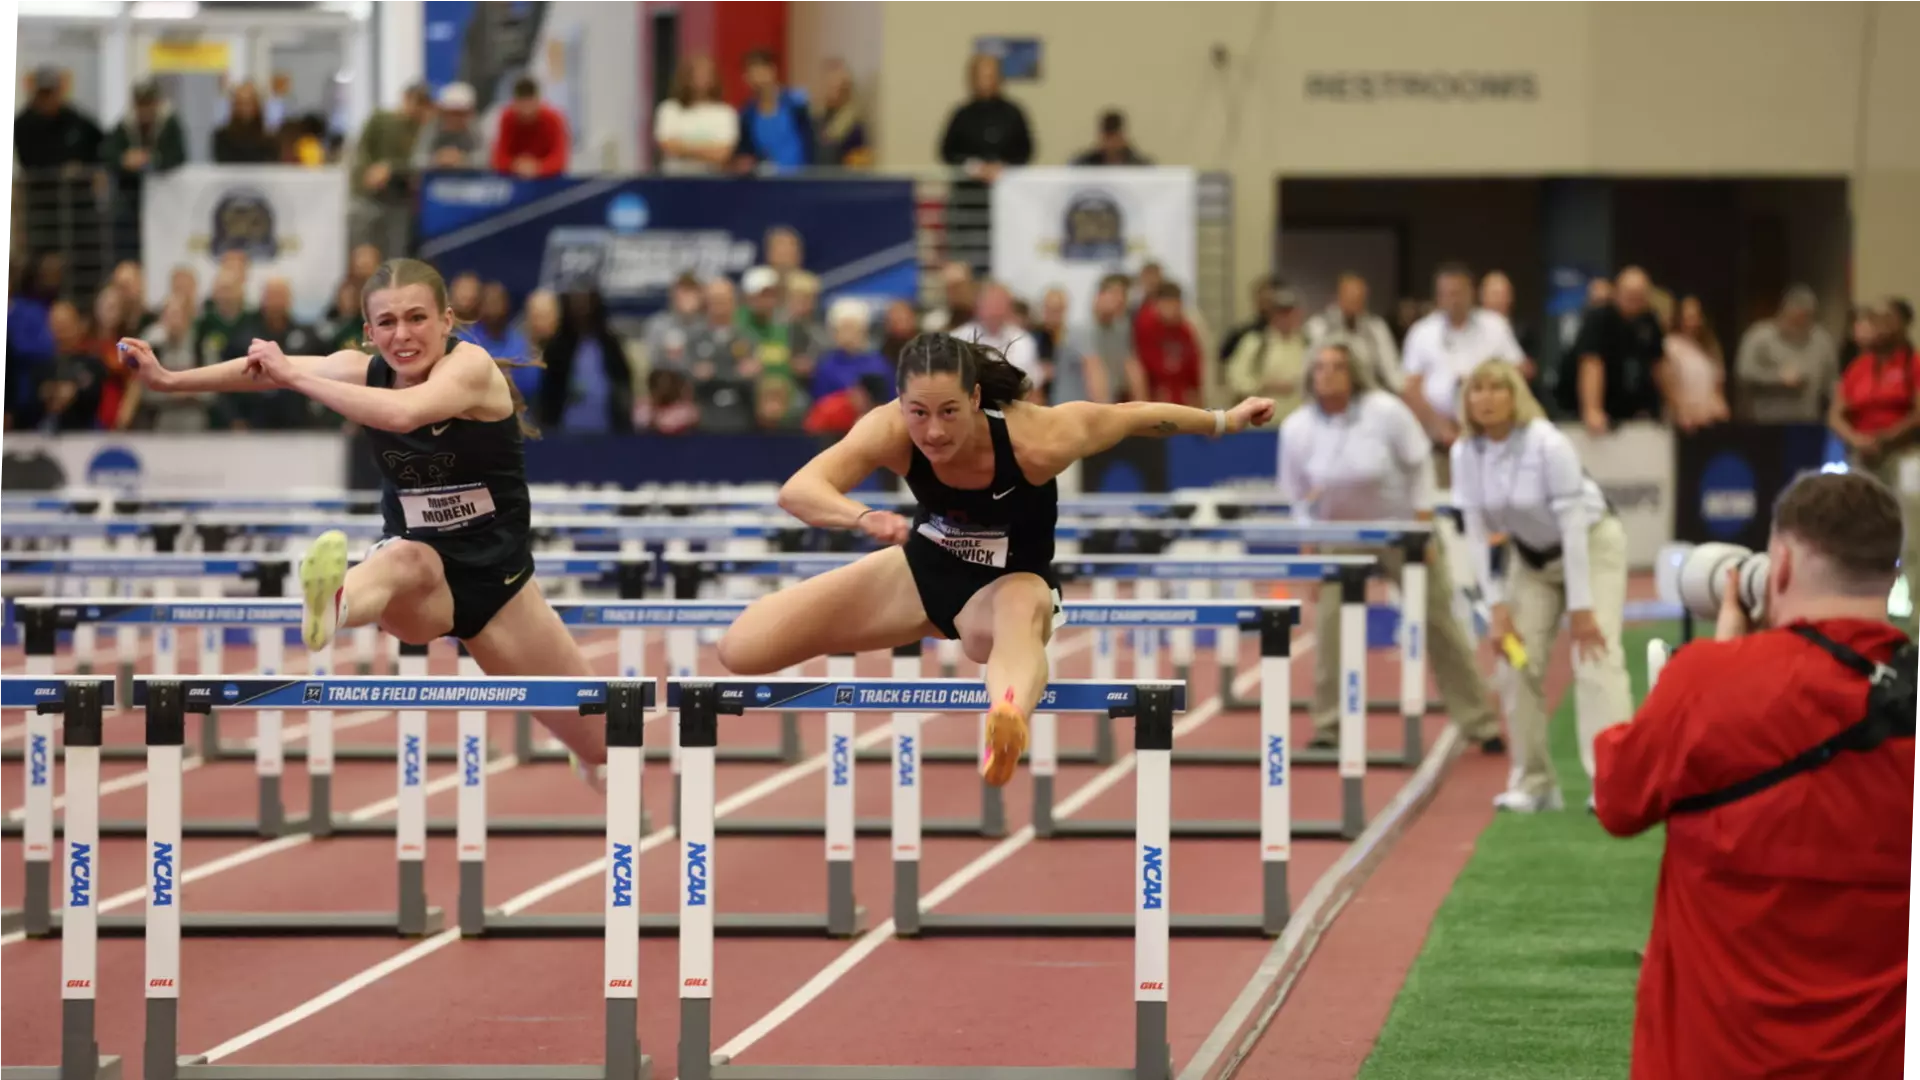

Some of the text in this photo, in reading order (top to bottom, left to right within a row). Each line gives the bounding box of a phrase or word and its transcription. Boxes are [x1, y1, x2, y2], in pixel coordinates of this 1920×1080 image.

[1303, 71, 1538, 102] RESTROOMS
[427, 495, 461, 508] MISSY
[422, 502, 477, 523] MORENI
[941, 539, 981, 548] NICOLE
[34, 687, 56, 696] GILL
[188, 687, 211, 696] GILL
[328, 686, 527, 702] TRACK & FIELD CHAMPIONSHIPS
[577, 688, 599, 697] GILL
[722, 690, 744, 698] GILL
[860, 689, 900, 704] TRACK
[901, 689, 911, 704] &
[912, 689, 947, 704] FIELD
[1107, 691, 1128, 700] GILL
[31, 734, 47, 786] NCAA
[404, 734, 420, 786] NCAA
[464, 734, 480, 786] NCAA
[832, 734, 848, 786] NCAA
[899, 734, 914, 786] NCAA
[1269, 735, 1283, 786] NCAA
[70, 842, 90, 907] NCAA
[153, 841, 173, 906] NCAA
[613, 843, 632, 907] NCAA
[687, 842, 706, 906] NCAA
[1143, 845, 1162, 910] NCAA
[66, 980, 91, 988] GILL
[149, 979, 174, 988] GILL
[609, 979, 632, 987] GILL
[684, 978, 708, 987] GILL
[1140, 982, 1164, 990] GILL
